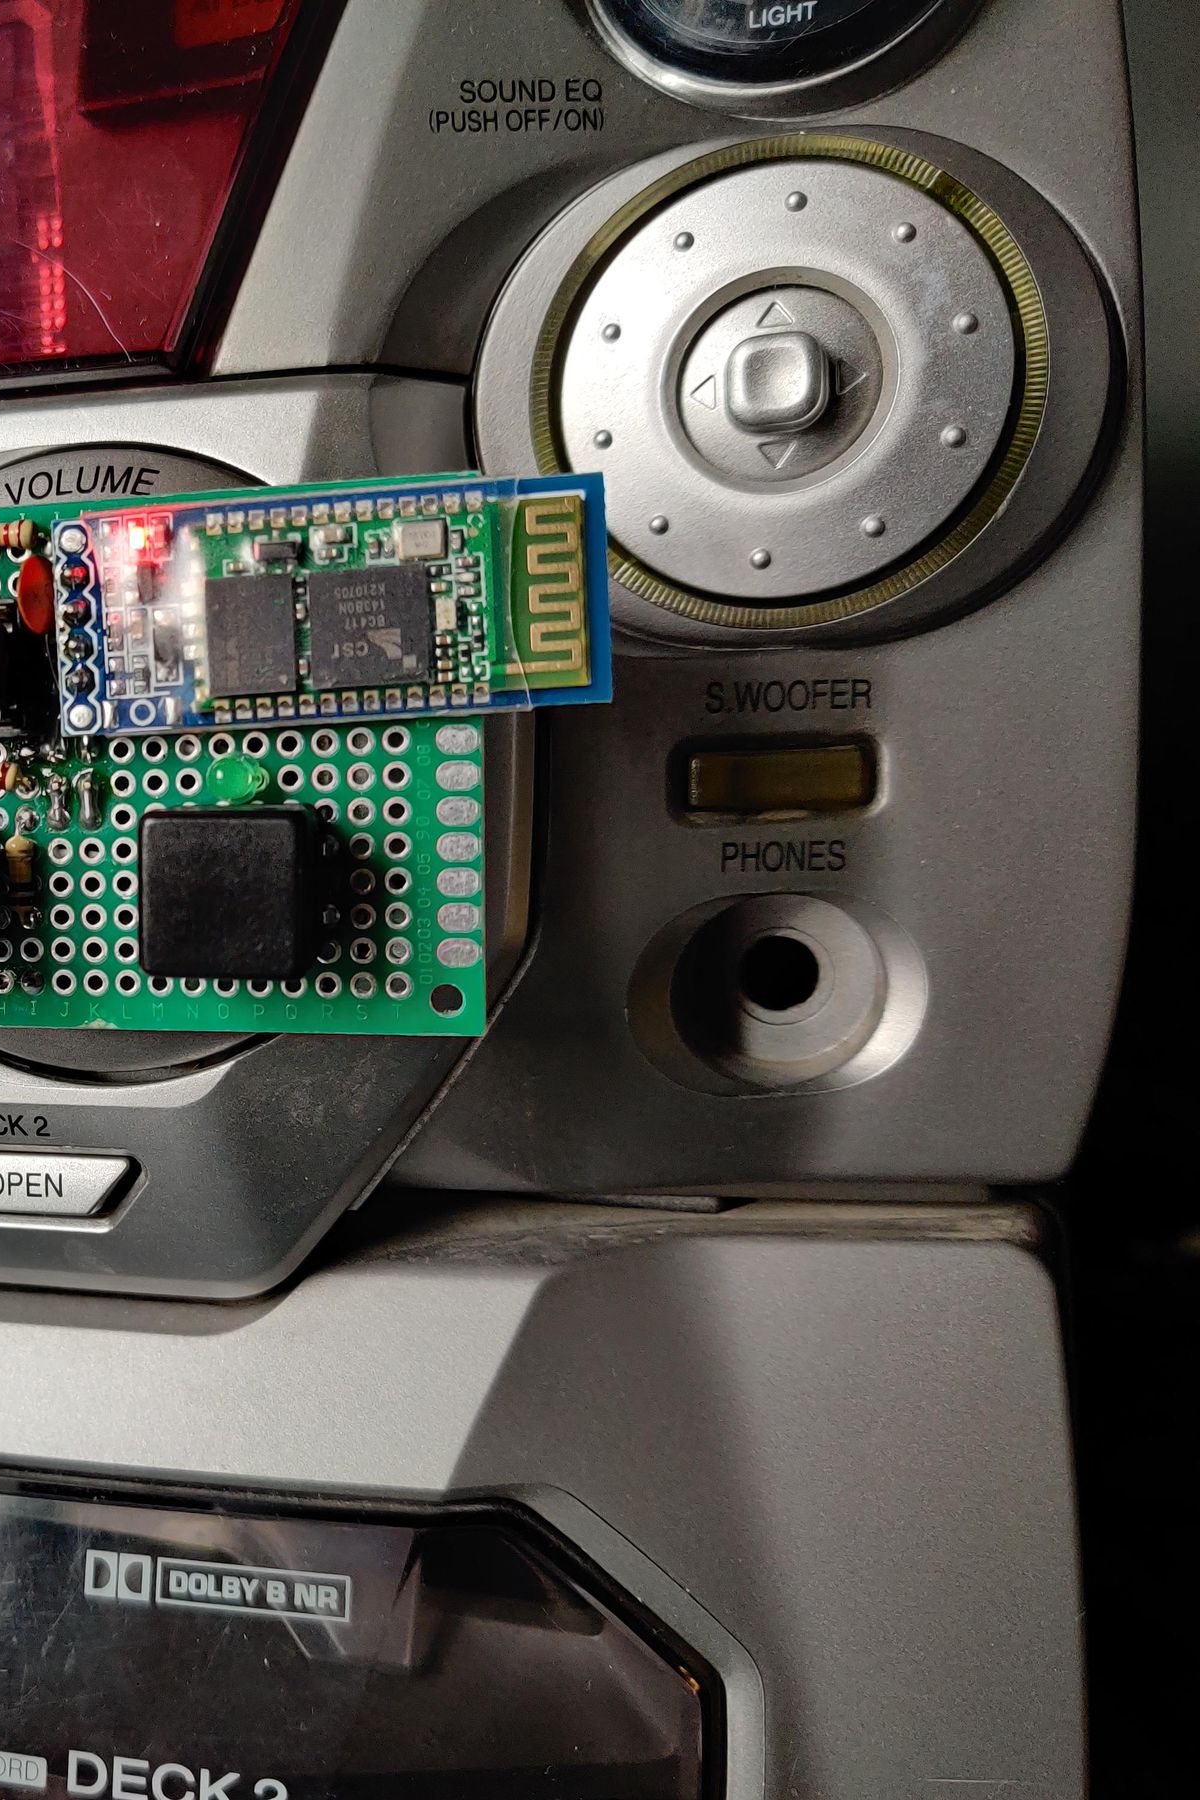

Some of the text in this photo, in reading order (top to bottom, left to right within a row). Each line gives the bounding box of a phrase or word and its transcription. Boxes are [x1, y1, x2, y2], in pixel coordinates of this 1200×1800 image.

[749, 1, 818, 29] LIGHT
[459, 78, 602, 103] SOUND EQ
[429, 108, 604, 133] (PUSH OFF/ON)
[4, 465, 160, 504] VOLUME
[704, 678, 872, 714] S.WOOFER
[720, 839, 847, 873] PHONES
[33, 1115, 51, 1136] 2
[169, 1570, 339, 1611] DOLBY B NR
[66, 1749, 241, 1800] DECK
